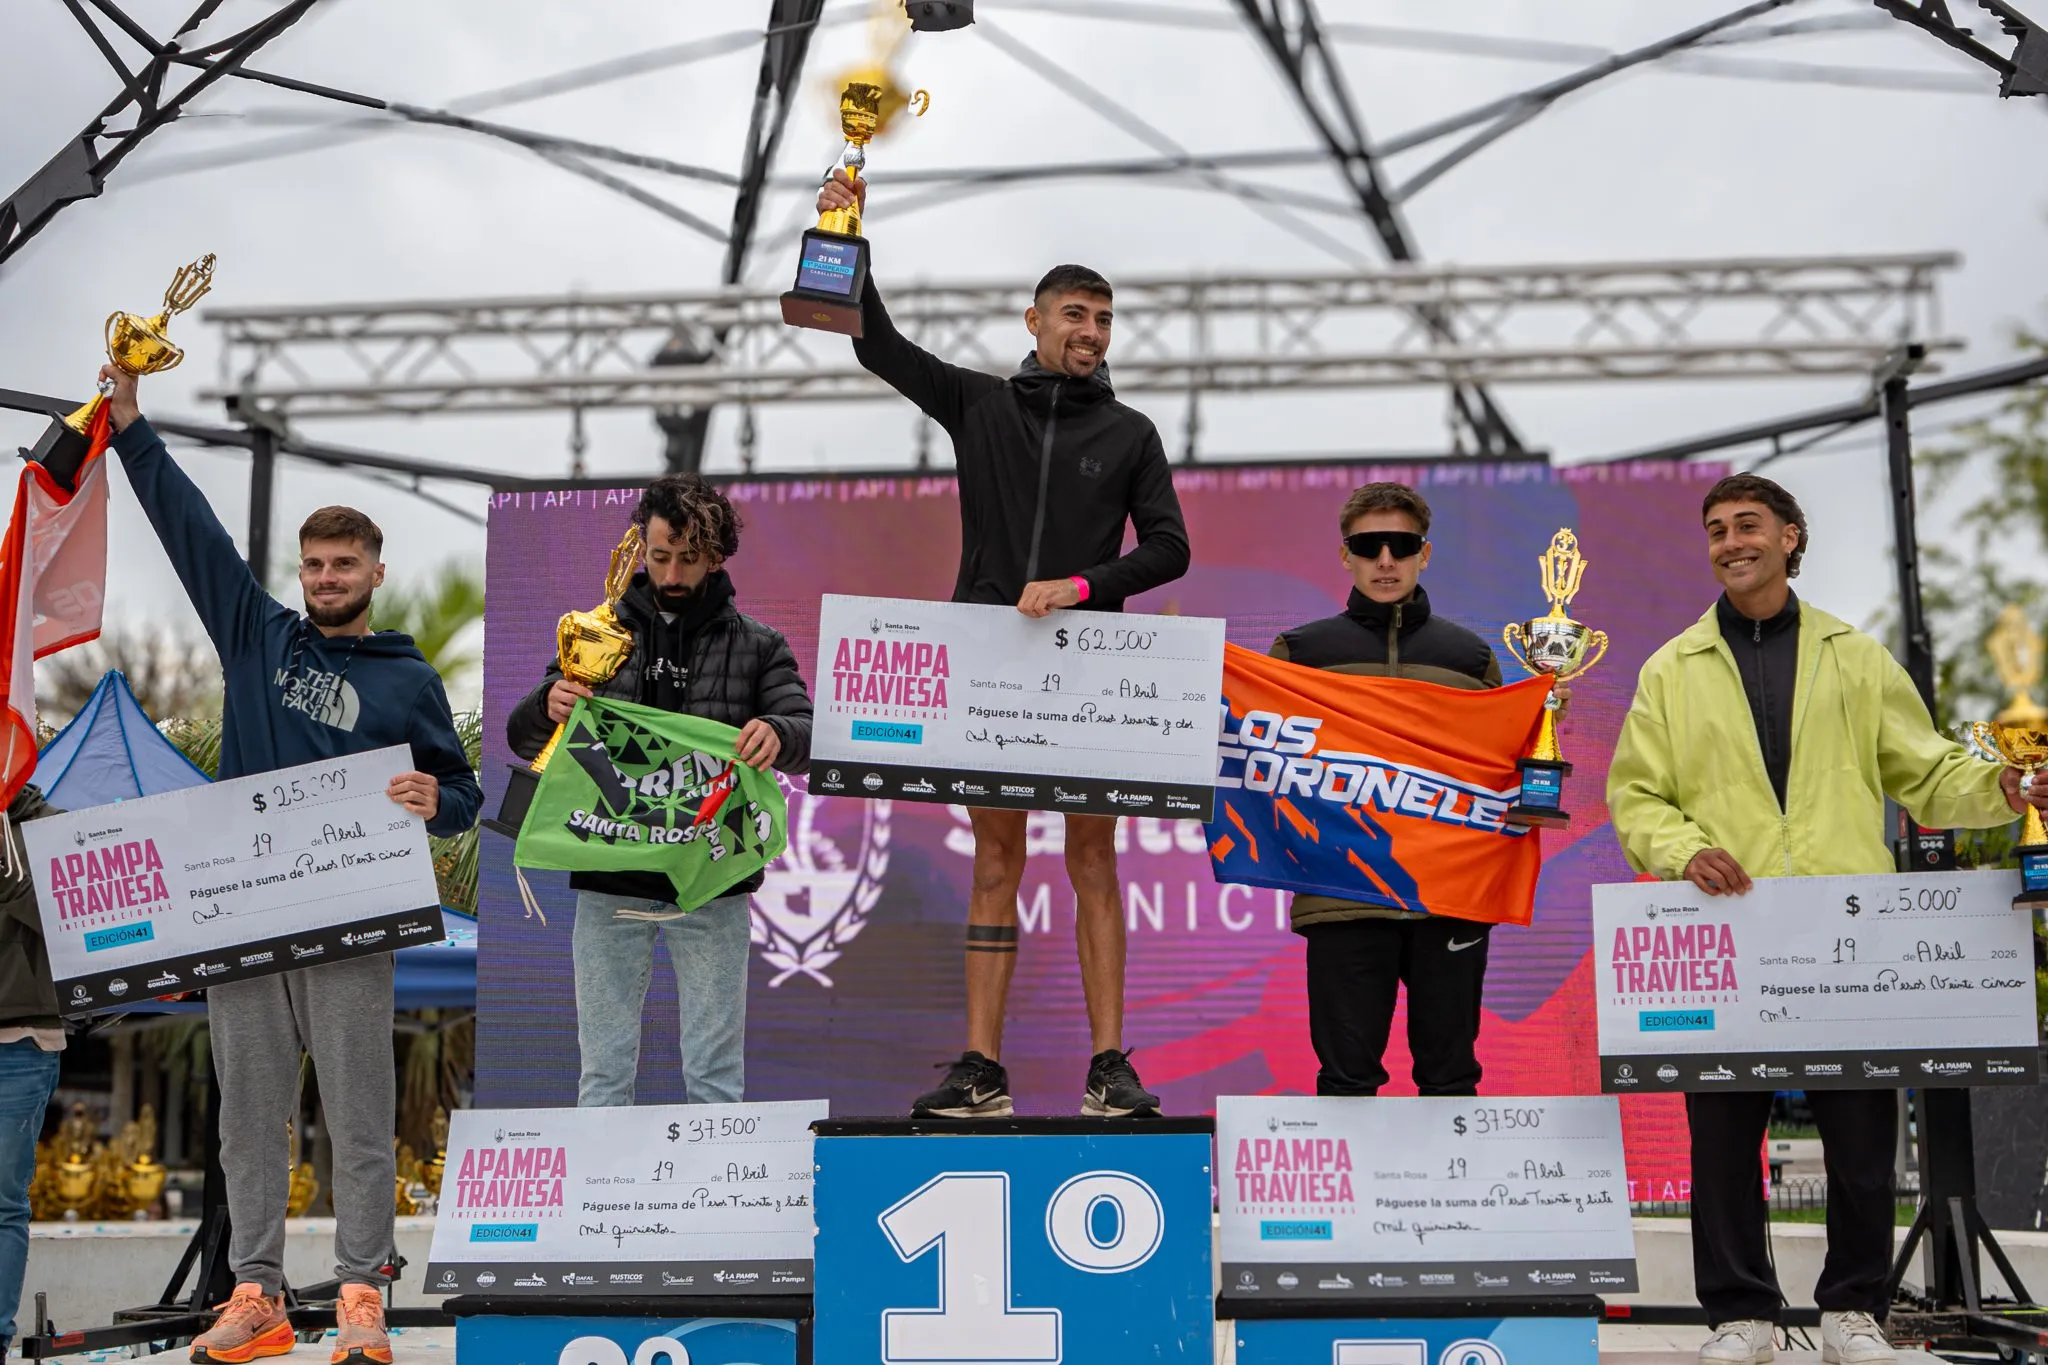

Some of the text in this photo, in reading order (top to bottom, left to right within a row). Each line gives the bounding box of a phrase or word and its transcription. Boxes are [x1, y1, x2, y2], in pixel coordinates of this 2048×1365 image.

[814, 263, 850, 274] PAMPEANO
[827, 256, 841, 265] KM
[1055, 628, 1069, 650] $
[833, 638, 950, 678] APAMPA
[306, 666, 334, 689] THE
[970, 674, 1206, 701] Santa Rosa 19 de Abril 2026
[833, 671, 948, 708] TRAVIESA
[281, 691, 321, 721] FACE
[830, 705, 947, 720] INTERNACIONAL
[968, 706, 1018, 721] Páguese
[1023, 710, 1033, 720] la
[1037, 713, 1068, 723] suma
[1072, 713, 1087, 723] de
[1176, 719, 1194, 729] dos
[1218, 703, 1323, 756] LOS
[1129, 795, 1153, 803] PAMPA
[1215, 747, 1531, 835] CORONELE
[252, 793, 267, 814] $
[1176, 801, 1200, 810] Pampa
[88, 830, 106, 839] Santa
[569, 809, 641, 842] SANTA
[184, 820, 411, 872] Santa Rosa 19 de Abril 2026
[50, 838, 164, 891] APAMPA
[190, 882, 239, 899] Páguese
[242, 880, 253, 890] la
[255, 873, 286, 887] suma
[289, 867, 304, 880] de
[53, 871, 170, 921] TRAVIESA
[1846, 894, 1861, 917] $
[59, 903, 173, 932] INTERNACIONAL
[353, 929, 386, 942] LA PAMPA
[1612, 924, 1736, 961] APAMPA
[1759, 937, 2018, 966] Santa Rosa 19 de Abril 2026
[1612, 960, 1738, 993] TRAVIESA
[1613, 995, 1738, 1005] INTERNACIONAL
[1761, 982, 1815, 997] Páguese
[1820, 984, 1831, 994] la
[1835, 984, 1869, 994] suma
[1873, 982, 1890, 993] de
[1760, 1006, 1792, 1023] mil
[1945, 1062, 1972, 1070] PAMPA
[1998, 1066, 2024, 1074] Pampa
[667, 1122, 680, 1143] $
[1453, 1115, 1467, 1136] $
[458, 1147, 567, 1179] APAMPA
[1235, 1138, 1353, 1172] APAMPA
[585, 1160, 812, 1185] Santa Rosa 19 de Abril 2026
[1374, 1157, 1612, 1180] Santa Rosa 19 de Abril 2026
[457, 1179, 563, 1208] TRAVIESA
[1235, 1173, 1354, 1203] TRAVIESA
[582, 1201, 631, 1213] Páguese
[634, 1201, 644, 1211] la
[648, 1202, 678, 1211] suma
[681, 1200, 696, 1210] de
[1376, 1197, 1427, 1209] Páguese
[1431, 1198, 1441, 1208] la
[1445, 1199, 1477, 1208] suma
[1481, 1197, 1496, 1208] de
[451, 1211, 563, 1219] INTERNACIONAL
[580, 1222, 607, 1237] mil
